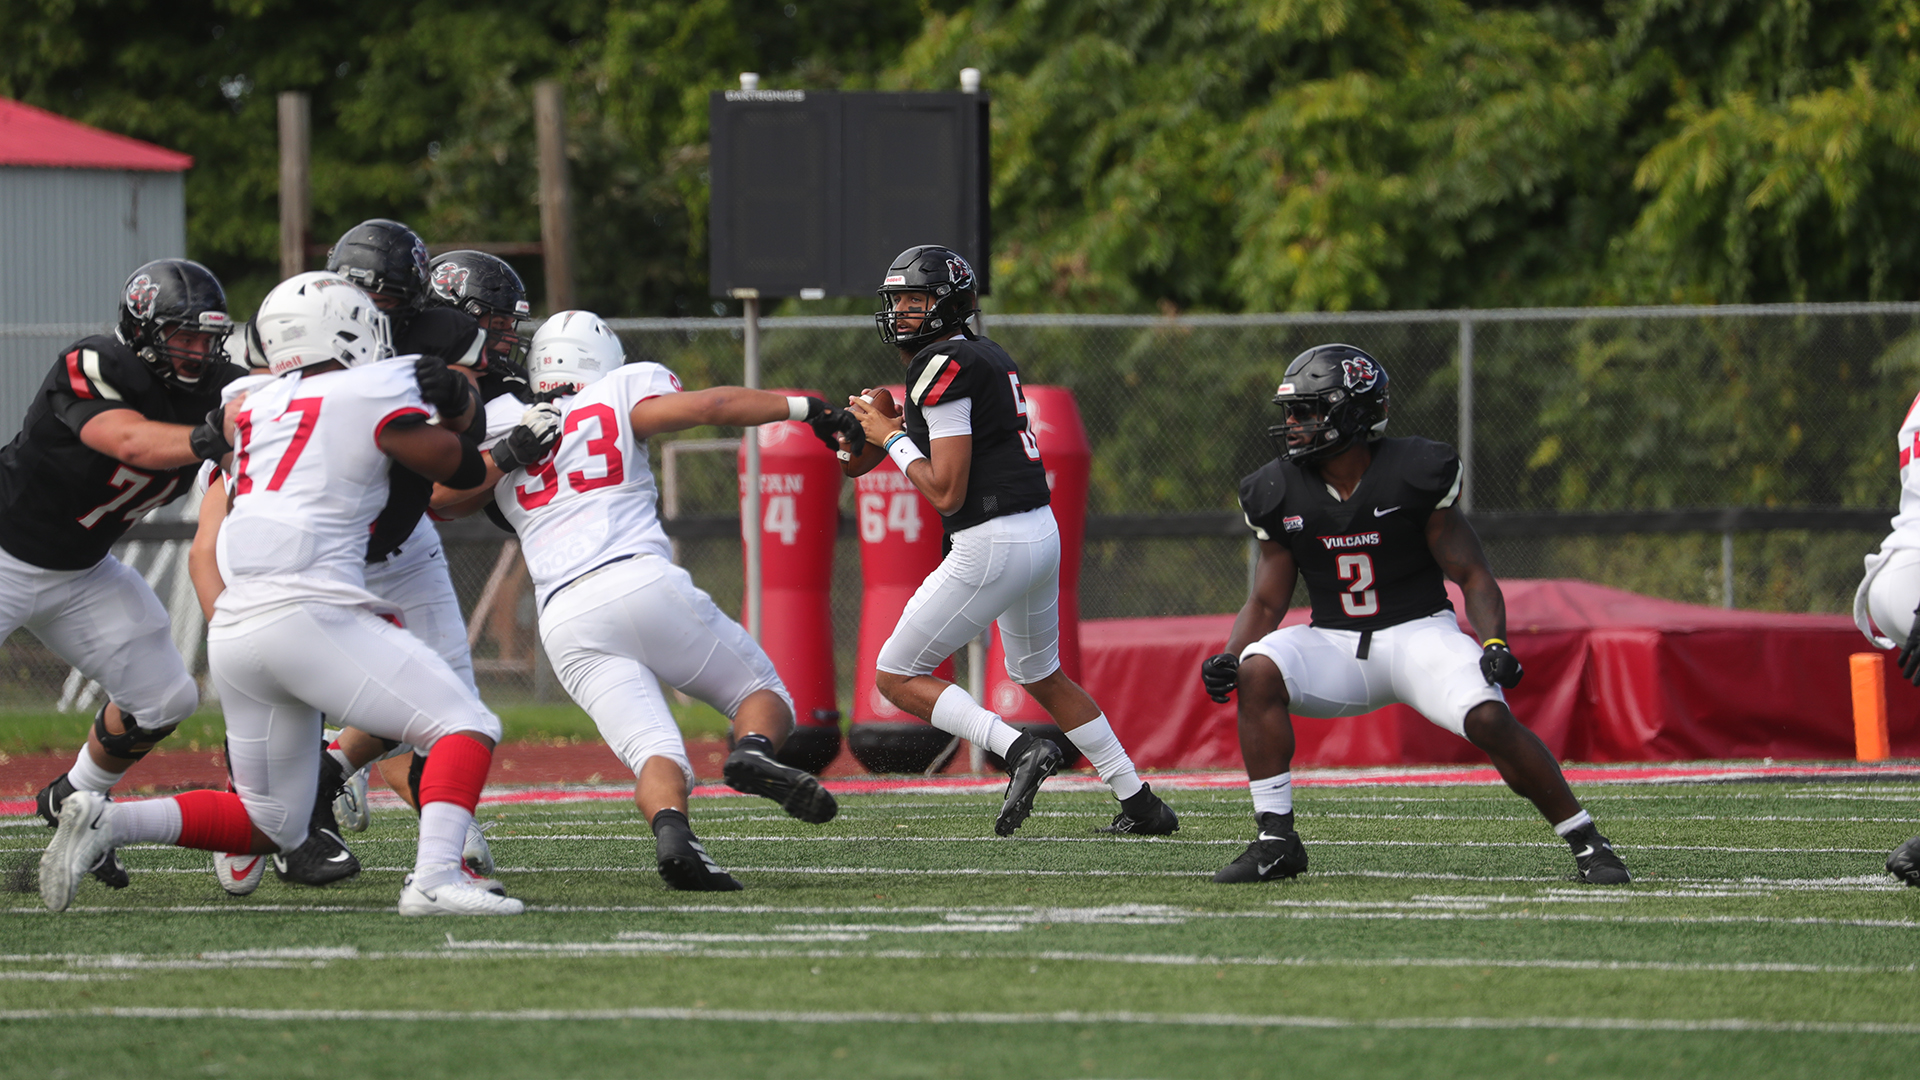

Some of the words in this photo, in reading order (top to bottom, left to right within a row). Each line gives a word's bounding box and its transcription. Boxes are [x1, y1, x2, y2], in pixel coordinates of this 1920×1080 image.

[234, 397, 324, 496] 17
[1007, 371, 1041, 461] 5
[858, 493, 924, 544] 64
[1321, 532, 1381, 550] VULCANS
